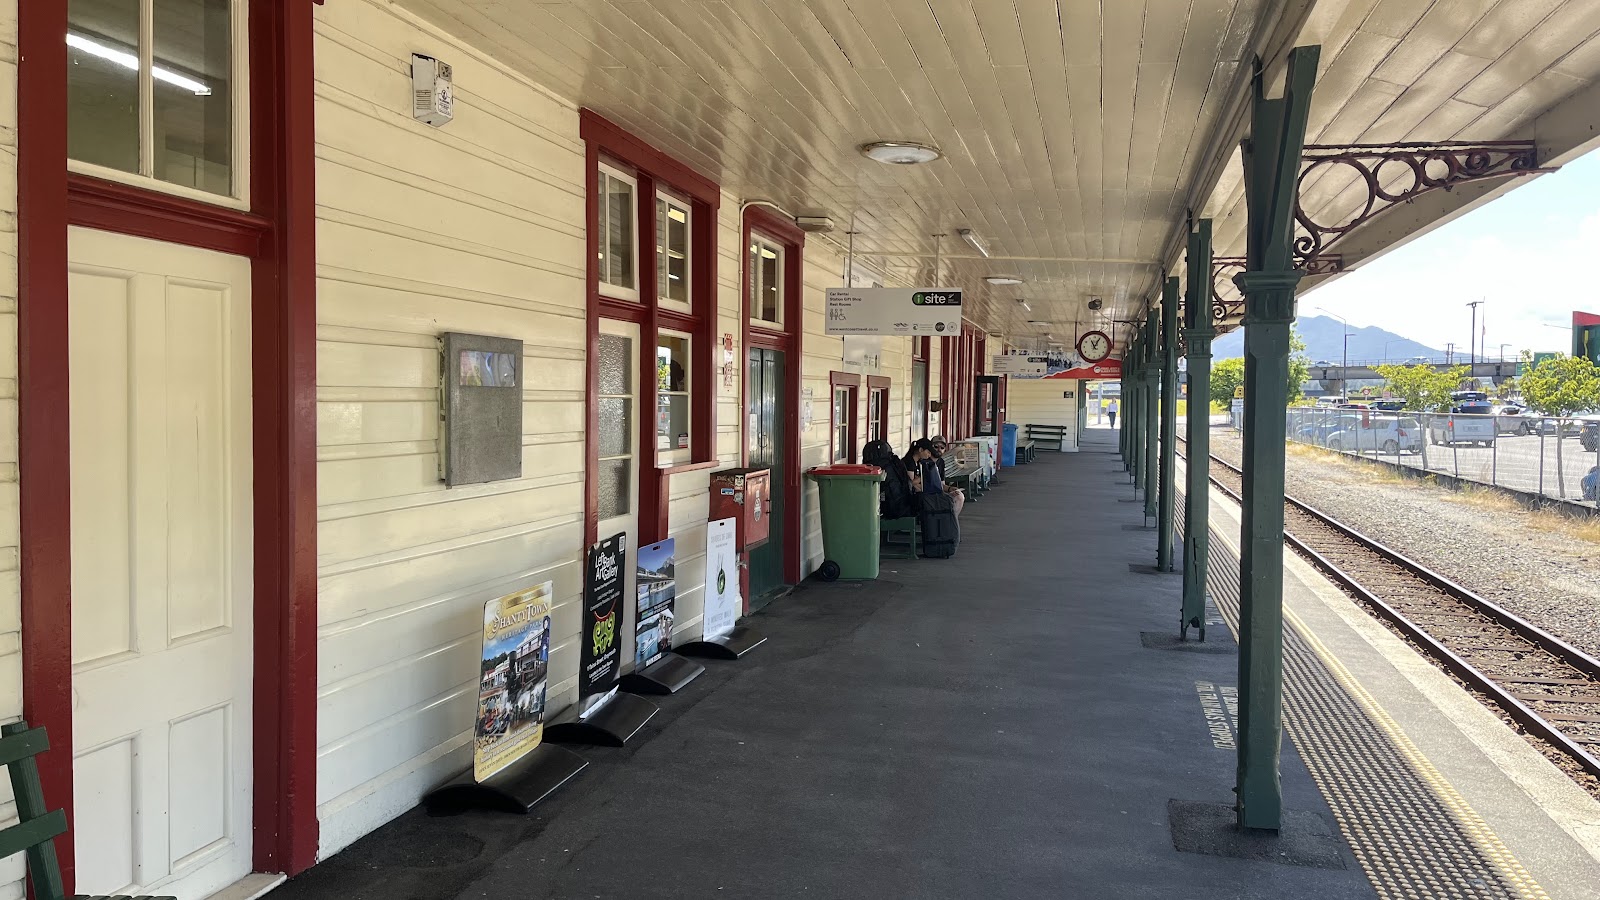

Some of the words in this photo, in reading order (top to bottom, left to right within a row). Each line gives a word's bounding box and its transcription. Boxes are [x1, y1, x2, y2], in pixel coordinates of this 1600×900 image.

[924, 293, 946, 304] site
[595, 552, 605, 568] Left
[1207, 721, 1237, 750] STOPPED
